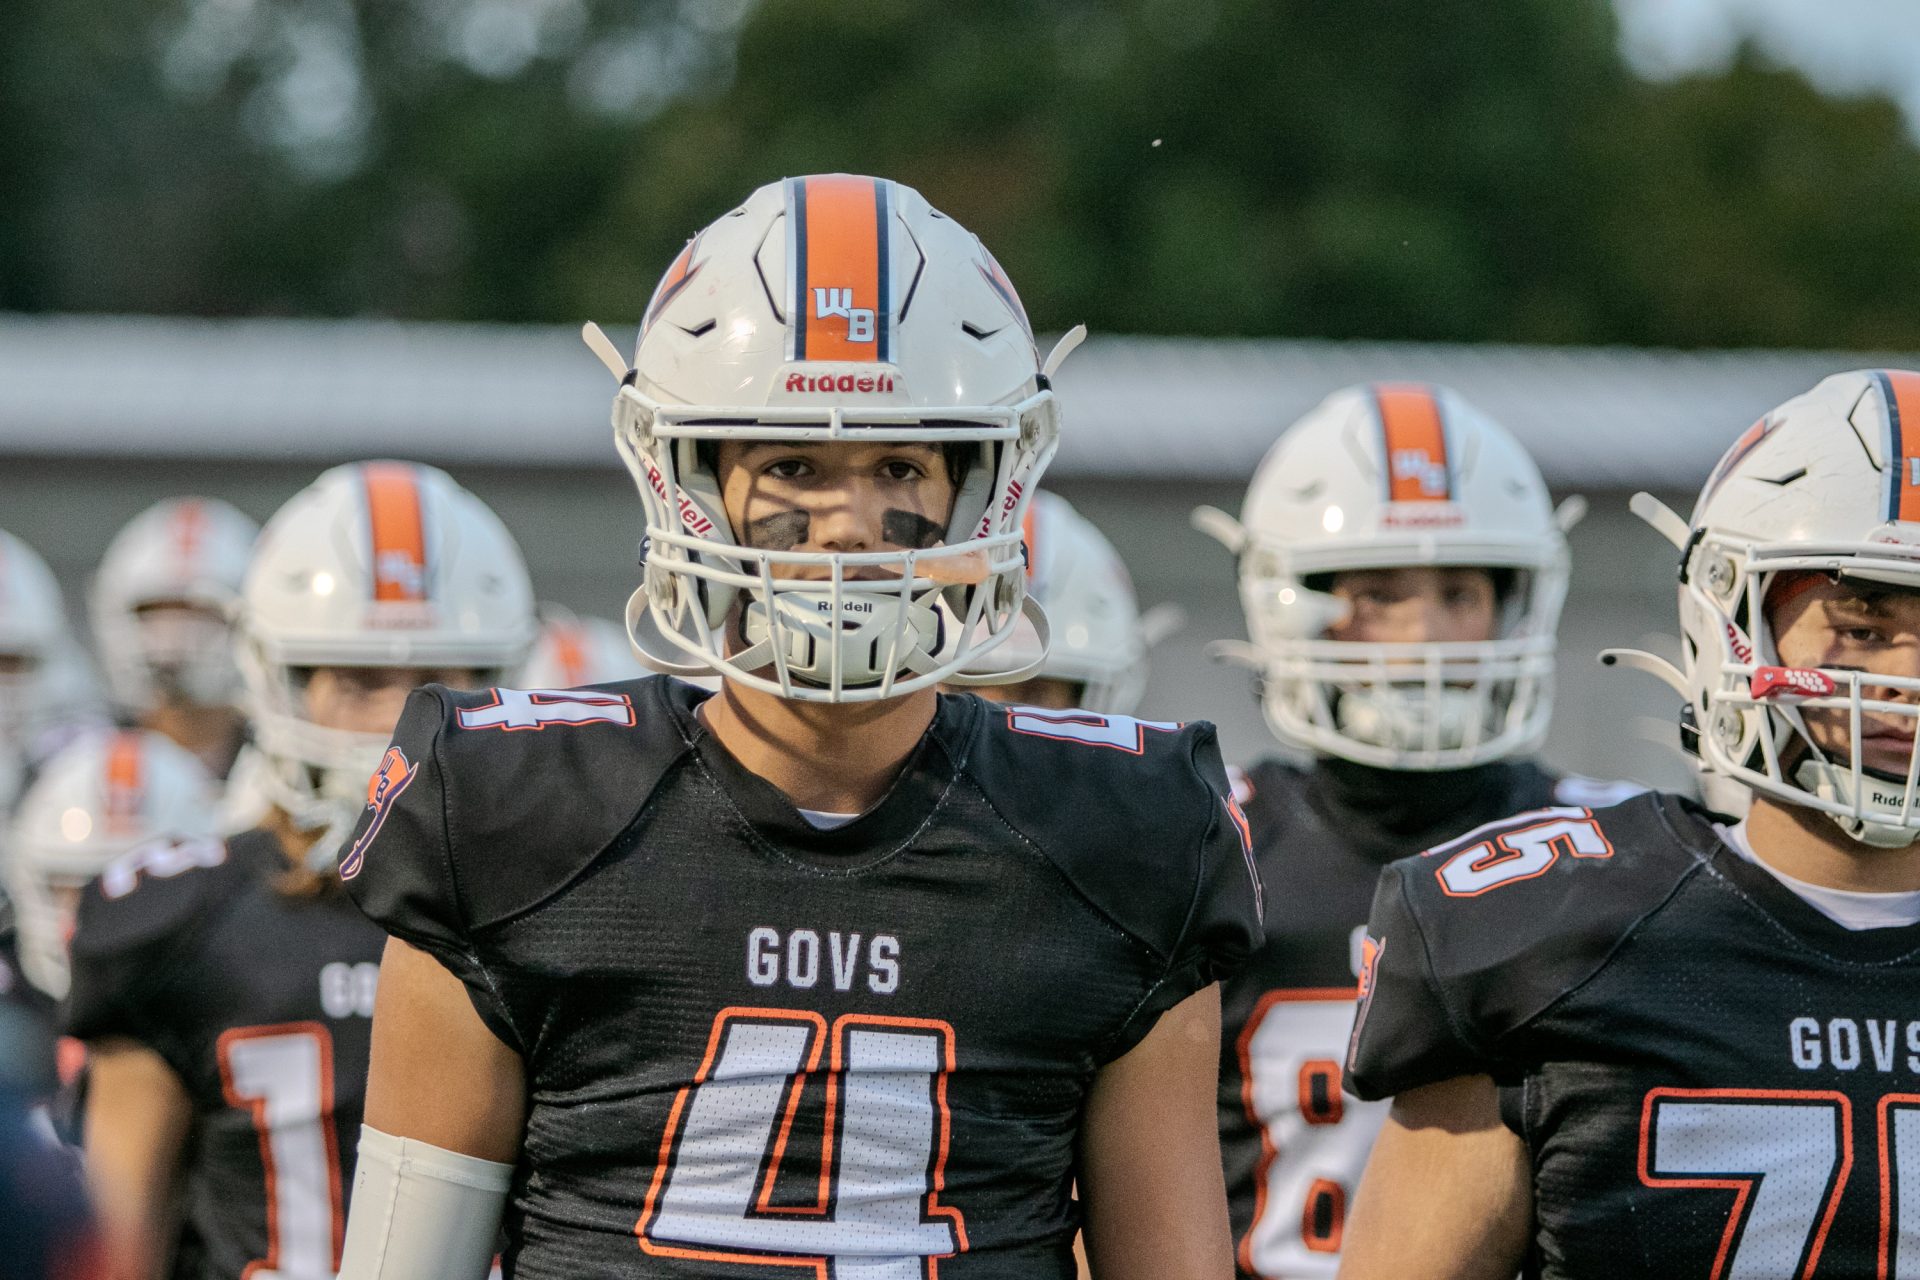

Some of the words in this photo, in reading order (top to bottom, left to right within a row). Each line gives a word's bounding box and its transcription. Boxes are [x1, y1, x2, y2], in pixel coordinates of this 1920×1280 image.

[786, 372, 893, 393] Riddell
[817, 601, 873, 613] Ridell
[747, 927, 900, 993] GOVS
[634, 1006, 970, 1280] 4
[1638, 1087, 1920, 1280] 7
